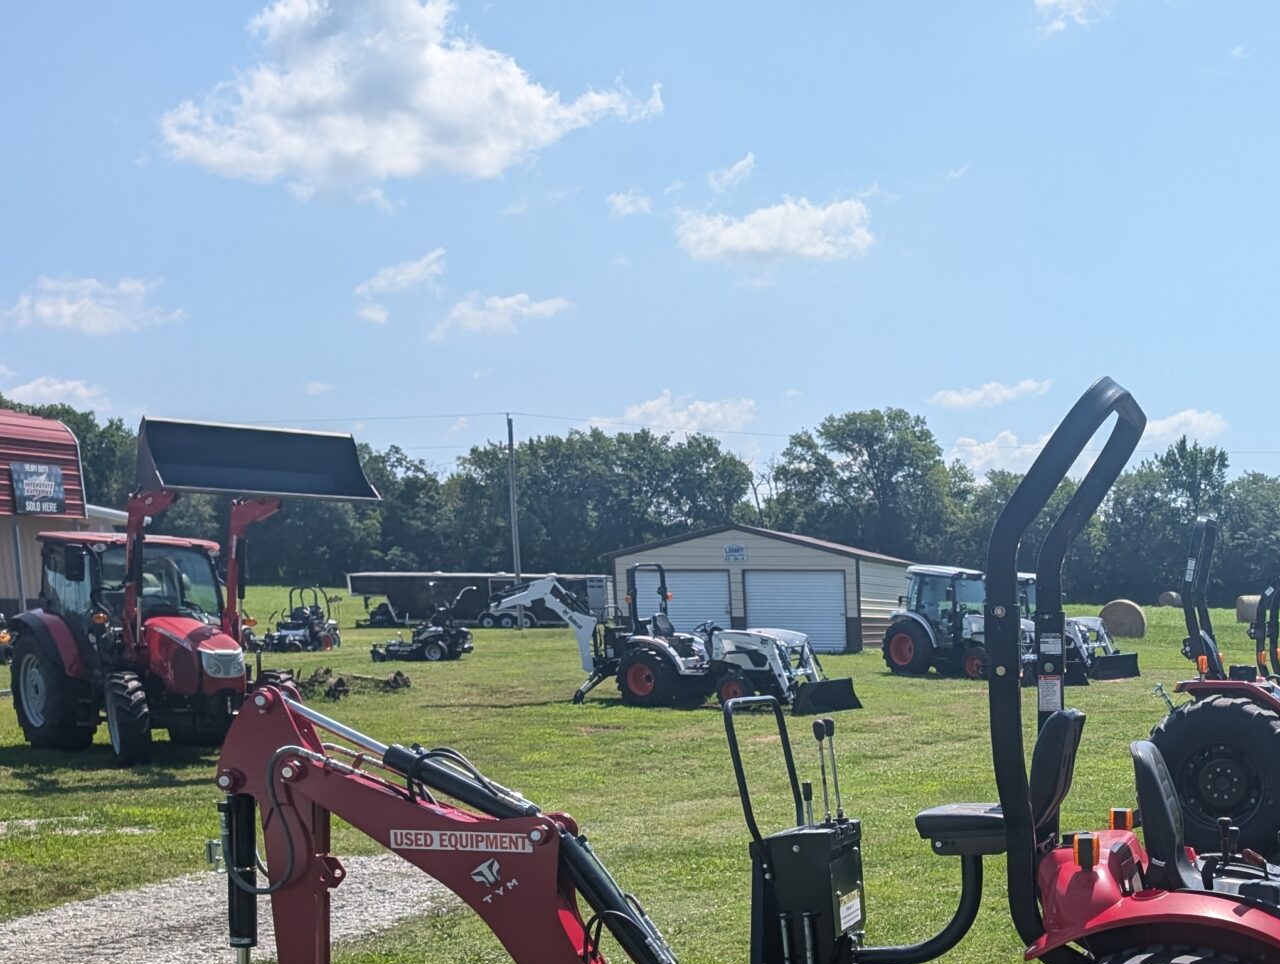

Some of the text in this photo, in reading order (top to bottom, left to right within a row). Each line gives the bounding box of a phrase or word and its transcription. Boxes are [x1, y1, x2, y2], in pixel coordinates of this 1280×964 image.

[25, 501, 58, 513] SOLD HERE
[394, 832, 528, 851] USED EQUIPMENT
[482, 878, 519, 904] TYM
